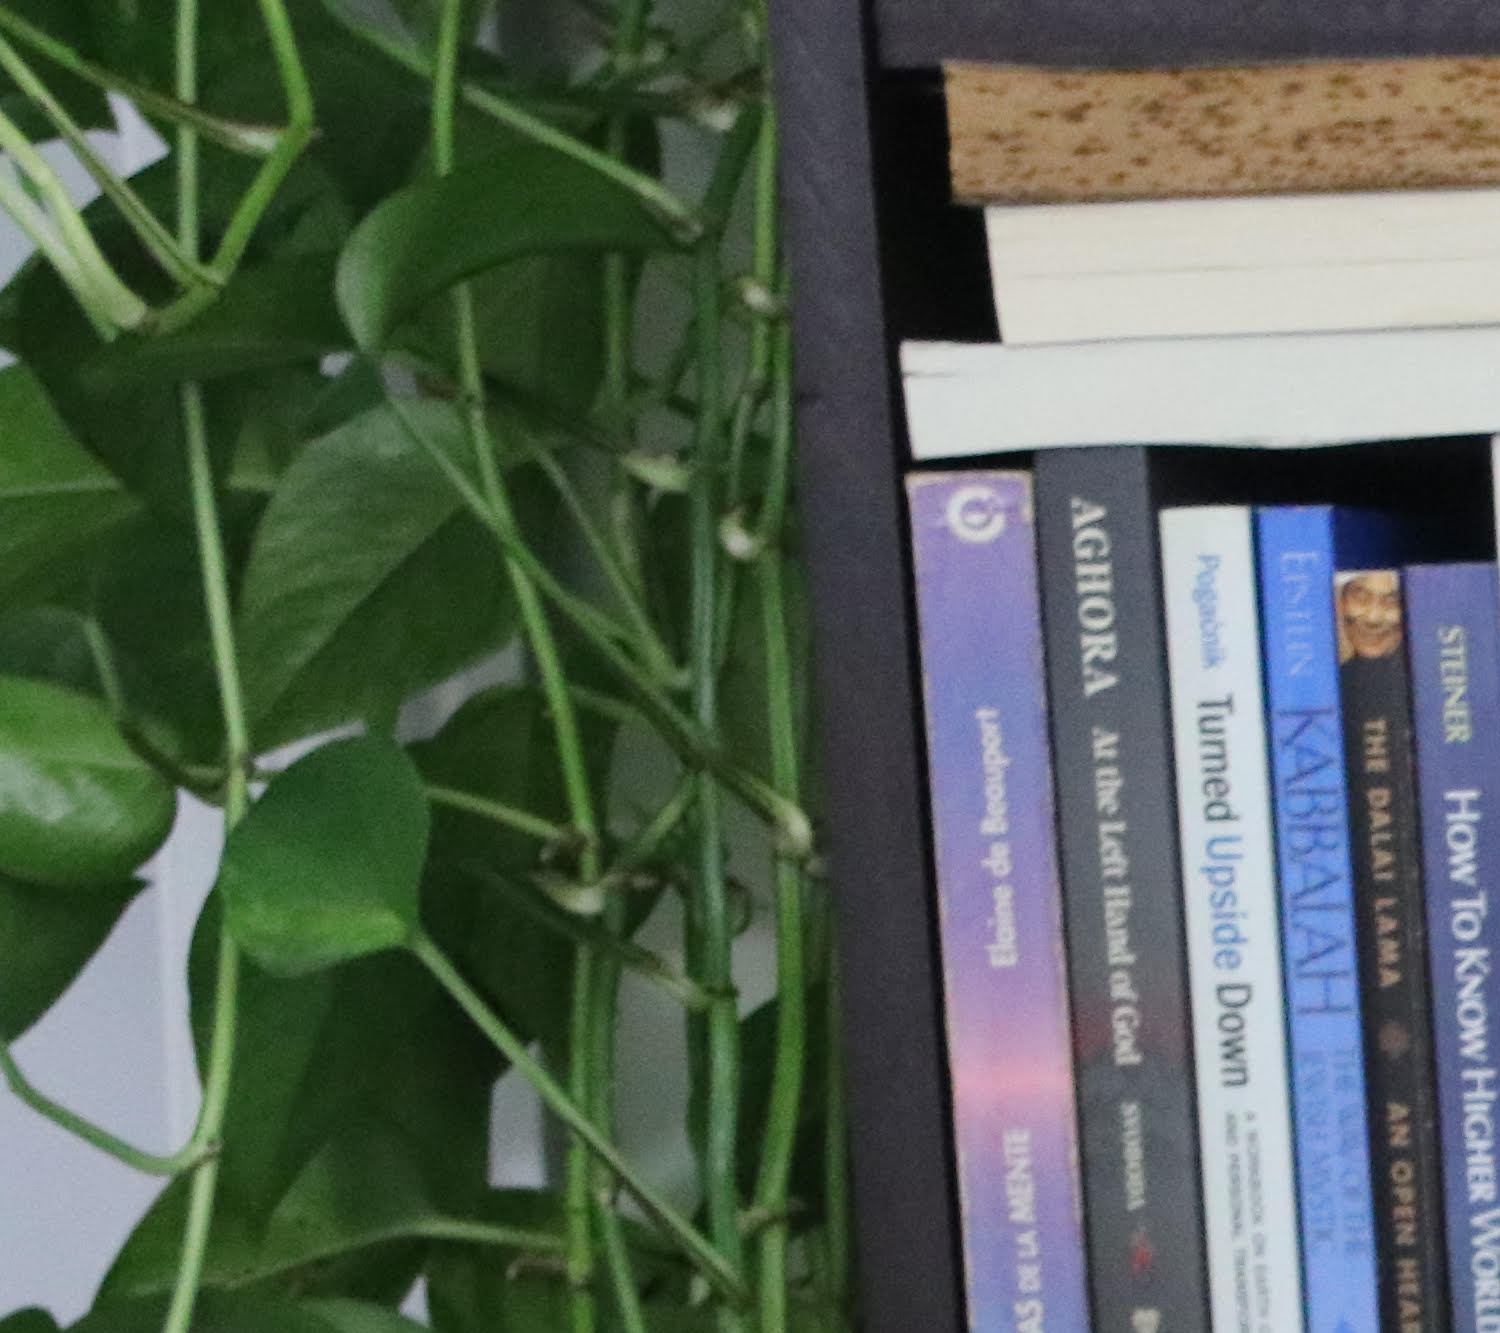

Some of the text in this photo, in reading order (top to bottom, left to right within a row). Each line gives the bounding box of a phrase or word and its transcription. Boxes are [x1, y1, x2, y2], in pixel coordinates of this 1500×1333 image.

[1437, 623, 1472, 744] STEINER
[1070, 496, 1143, 1065] AGHORA At the Left Hand of God
[1195, 694, 1239, 822] Turned
[975, 708, 1019, 968] Elaine de Beauport
[1271, 705, 1356, 1016] KABBALAH
[1363, 717, 1402, 987] THE DALAI LAMA
[1203, 836, 1247, 970] Upside
[1214, 983, 1253, 1087] Down
[1002, 1130, 1035, 1223] MENTE
[1385, 1101, 1411, 1146] AN
[1016, 1230, 1038, 1257] LA
[1390, 1161, 1418, 1246] OPEN
[1018, 1265, 1041, 1291] DE
